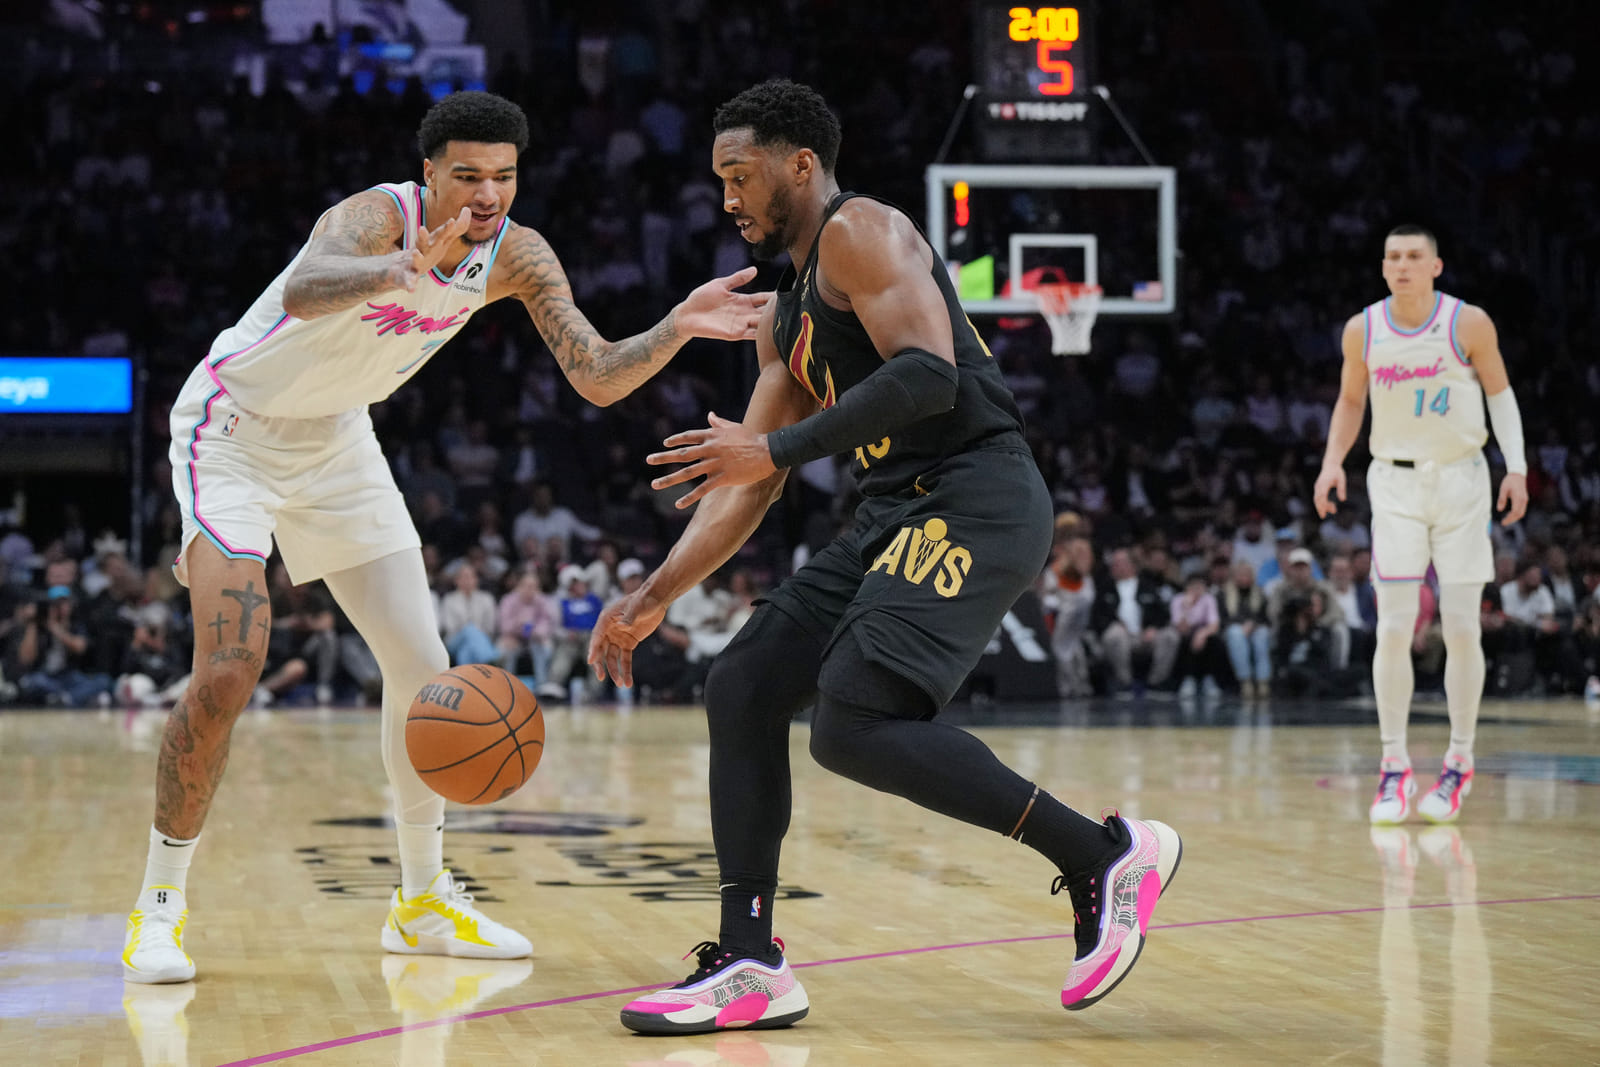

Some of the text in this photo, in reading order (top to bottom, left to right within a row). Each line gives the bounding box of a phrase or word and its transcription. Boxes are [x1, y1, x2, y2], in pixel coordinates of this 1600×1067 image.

[1008, 7, 1079, 42] 2:00
[1037, 40, 1074, 96] 5
[1373, 356, 1448, 391] Miami
[1414, 387, 1450, 417] 14
[865, 518, 973, 598] AVS
